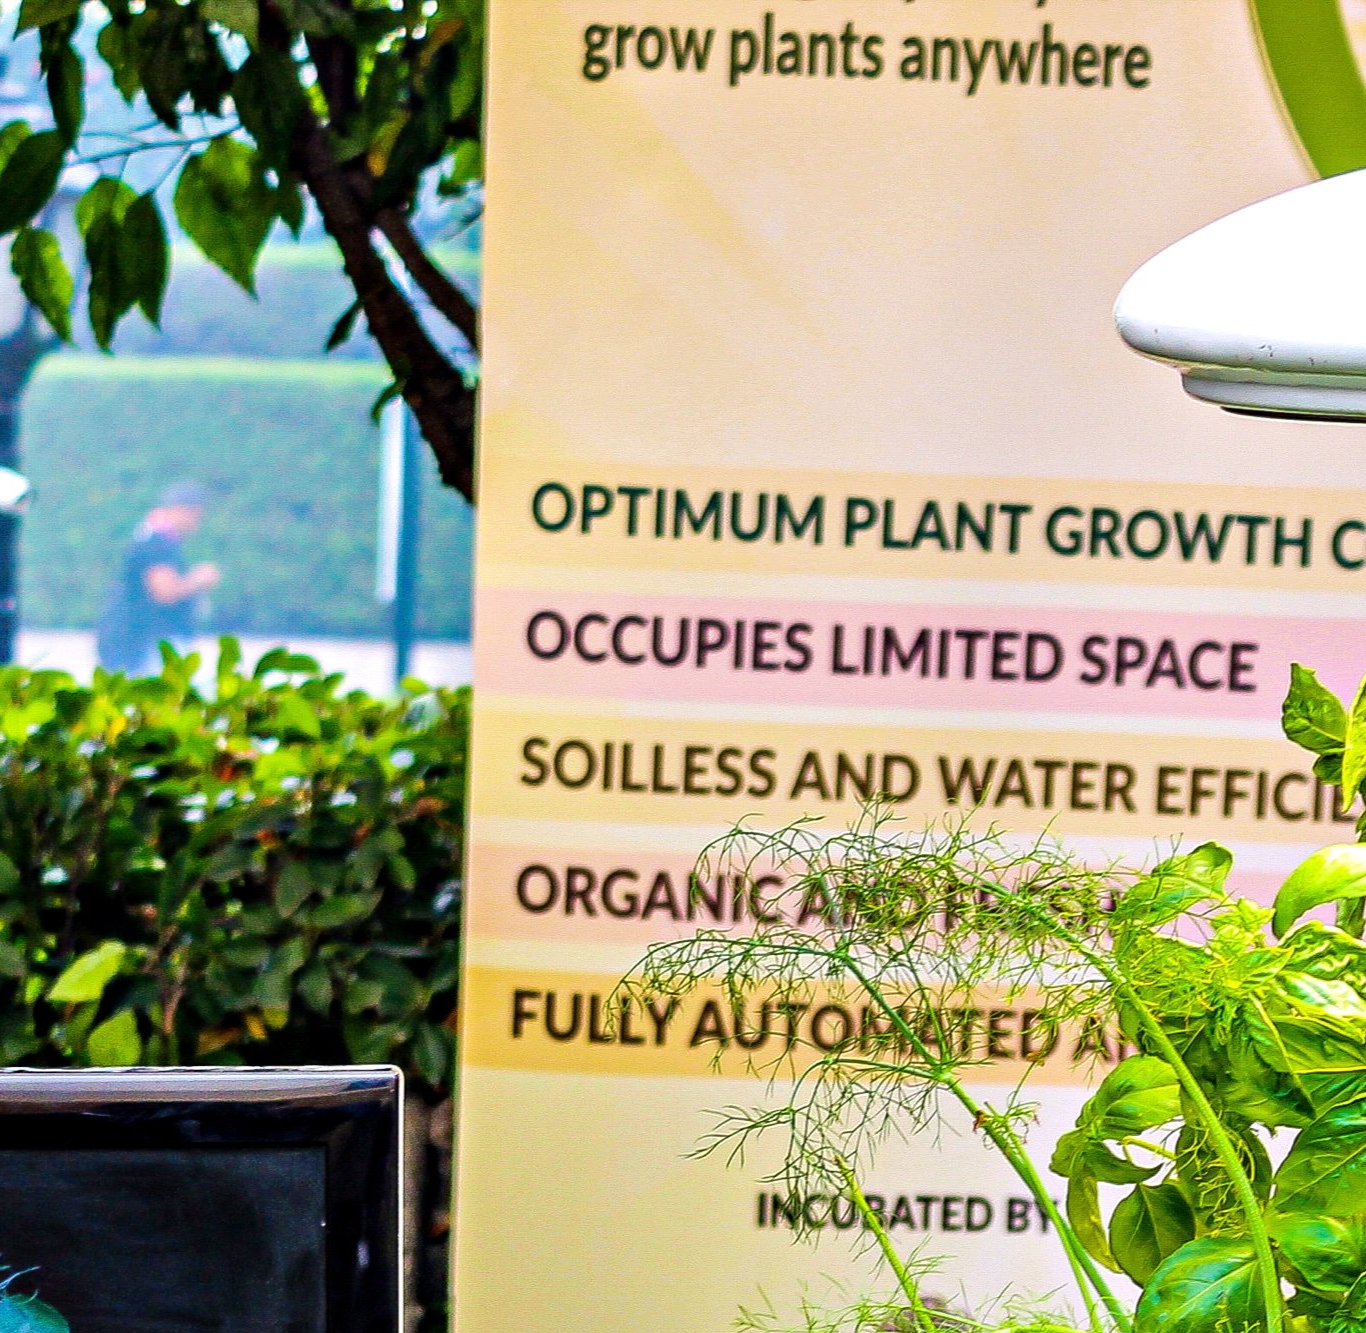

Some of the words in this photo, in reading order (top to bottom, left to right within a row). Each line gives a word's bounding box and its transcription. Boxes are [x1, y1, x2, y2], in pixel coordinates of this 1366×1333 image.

[581, 22, 715, 82] grow
[731, 12, 884, 86] plants
[900, 23, 1153, 96] anywhere
[533, 481, 825, 545] OPTIMUM
[843, 497, 1032, 555] PLANT
[1045, 504, 1313, 569] GROWTH
[526, 611, 813, 673] OCCUPIES
[831, 625, 1064, 682] LIMITED
[1080, 635, 1259, 693] SPACE
[520, 738, 777, 798] SOILLESS
[790, 750, 921, 804] AND
[938, 756, 1136, 815] WATER
[516, 864, 784, 925] ORGANIC
[511, 988, 678, 1046] FULLY
[689, 998, 1061, 1062] AUTOMATED
[757, 1192, 993, 1233] INCUBATED
[1007, 1196, 1059, 1234] BY
